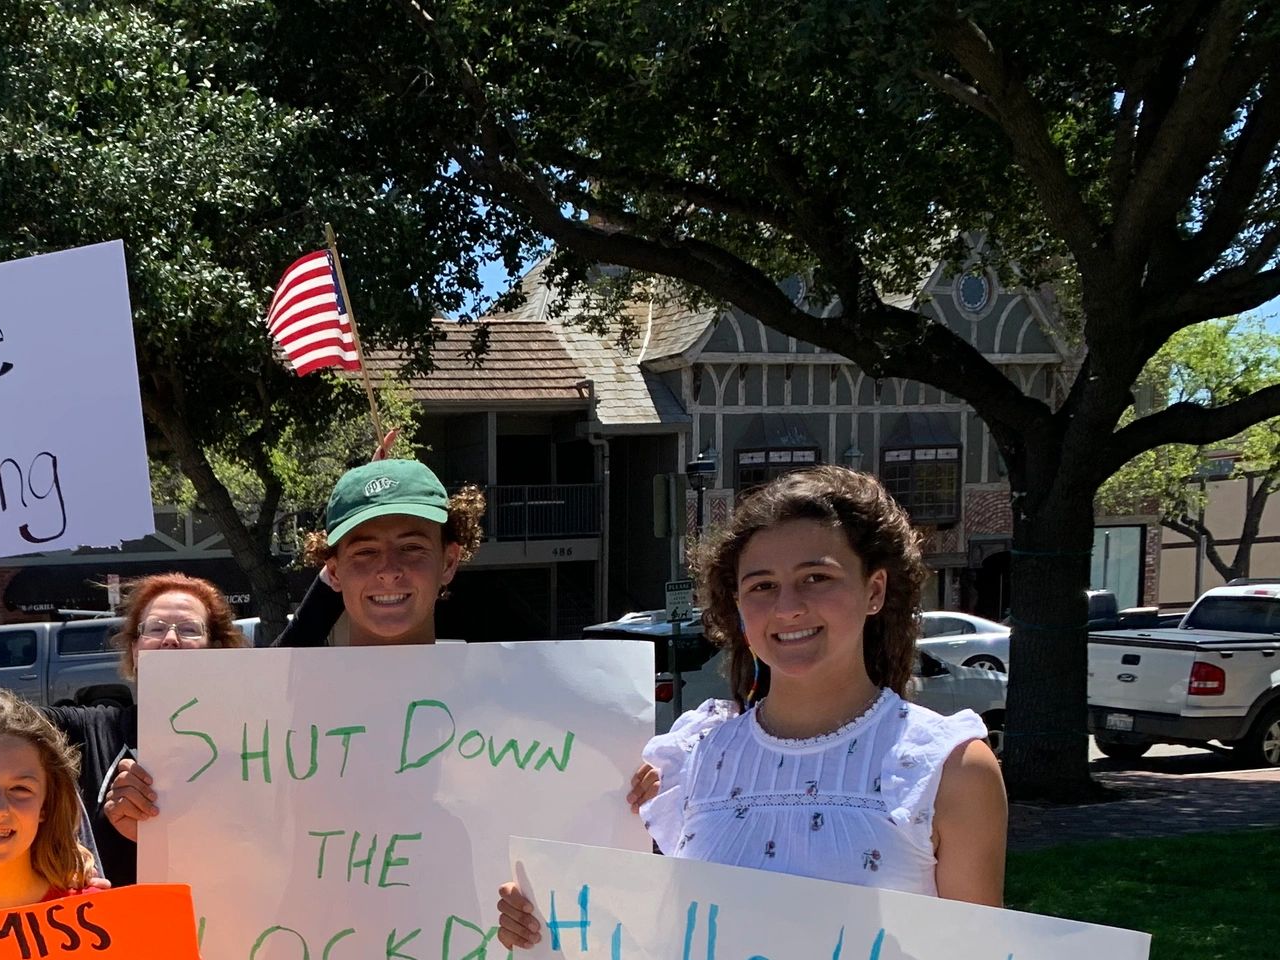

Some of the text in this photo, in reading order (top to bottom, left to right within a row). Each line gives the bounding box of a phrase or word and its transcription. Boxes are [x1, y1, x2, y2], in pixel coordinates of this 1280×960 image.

[552, 547, 573, 557] 486
[169, 697, 576, 784] SHUT DOWN
[308, 830, 422, 889] THE
